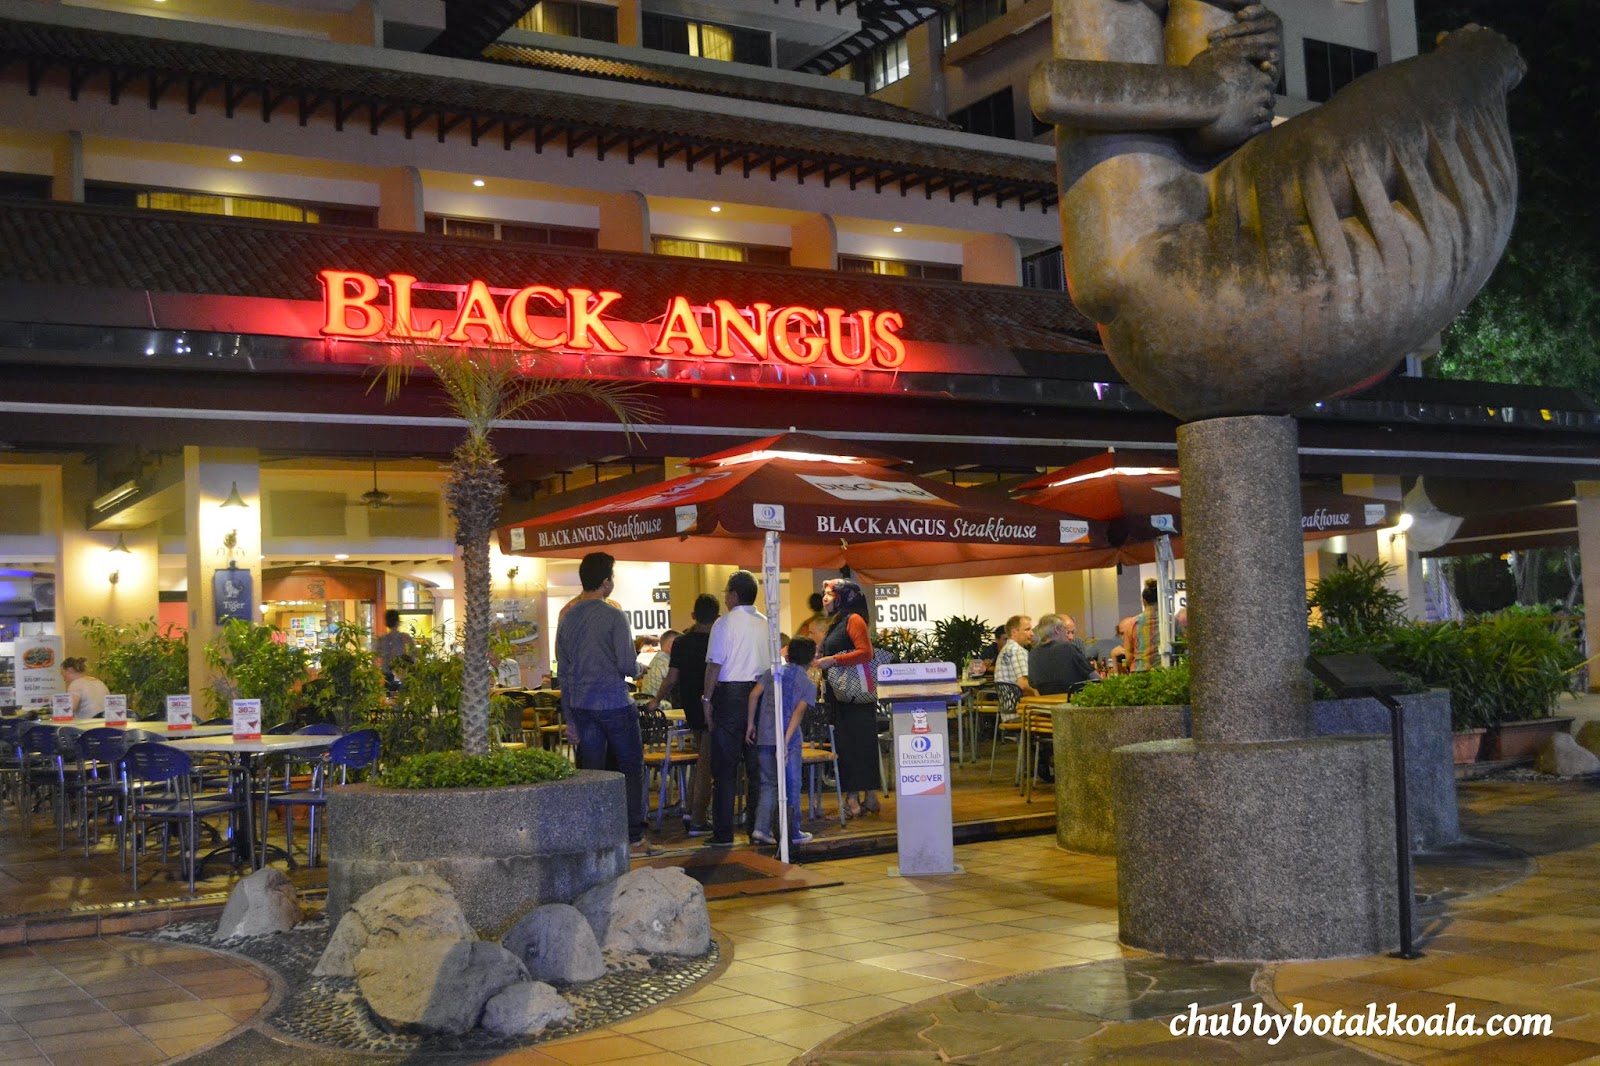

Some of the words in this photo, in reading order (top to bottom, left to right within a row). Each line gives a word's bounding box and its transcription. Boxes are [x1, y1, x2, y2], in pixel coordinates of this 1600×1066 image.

[317, 270, 629, 352] BLACK
[650, 296, 906, 368] ANGUS
[816, 515, 882, 534] BLACK
[886, 518, 945, 536] ANGUS
[949, 516, 1037, 542] Steakhouse
[1302, 508, 1350, 530] eakhouse
[538, 529, 571, 547] BLACK
[572, 525, 605, 544] ANGUS
[606, 514, 662, 541] Steakhouse
[223, 601, 245, 612] Tiger
[889, 604, 927, 622] SOON
[902, 752, 924, 760] Diners
[901, 774, 942, 783] DISCOVER
